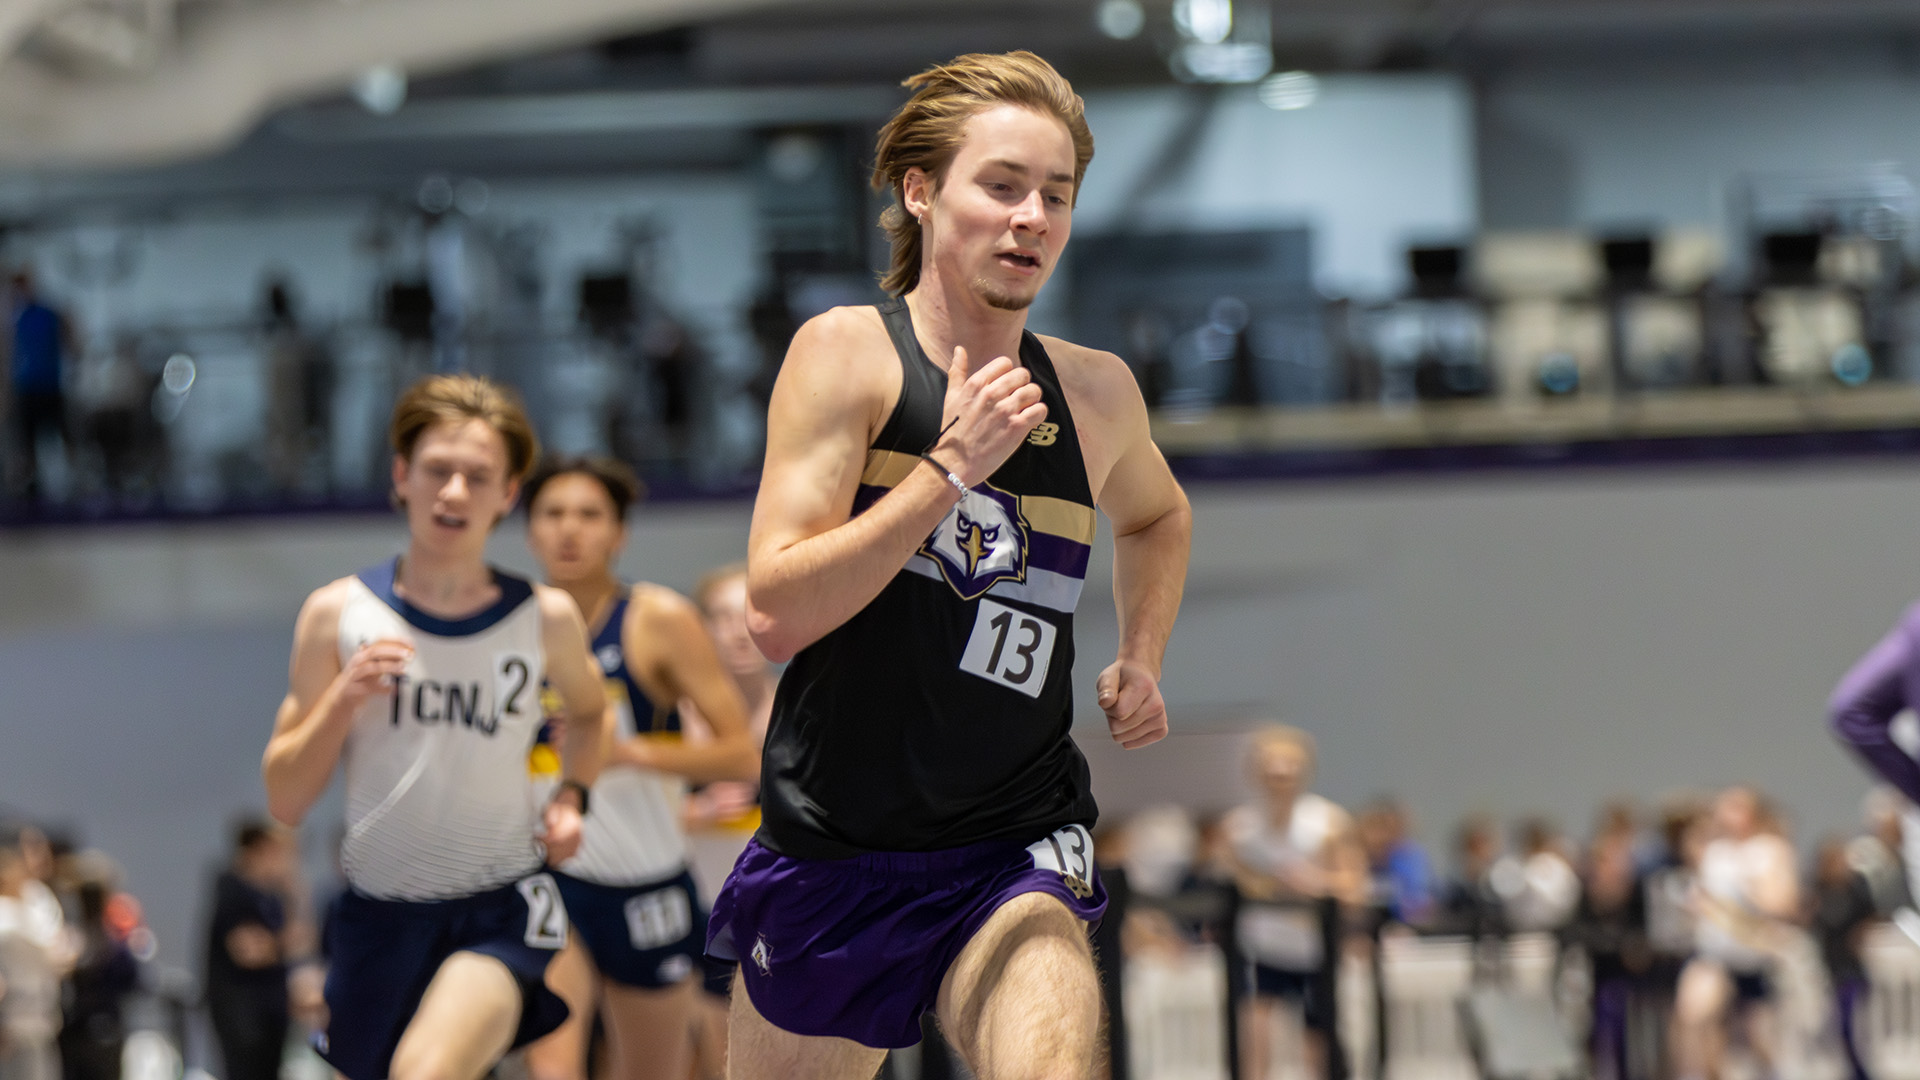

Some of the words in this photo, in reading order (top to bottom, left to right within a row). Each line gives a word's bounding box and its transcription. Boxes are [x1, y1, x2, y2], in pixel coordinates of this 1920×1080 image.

[986, 610, 1042, 684] 13
[502, 657, 529, 715] 2
[1046, 825, 1087, 881] 13
[532, 885, 558, 938] 2
